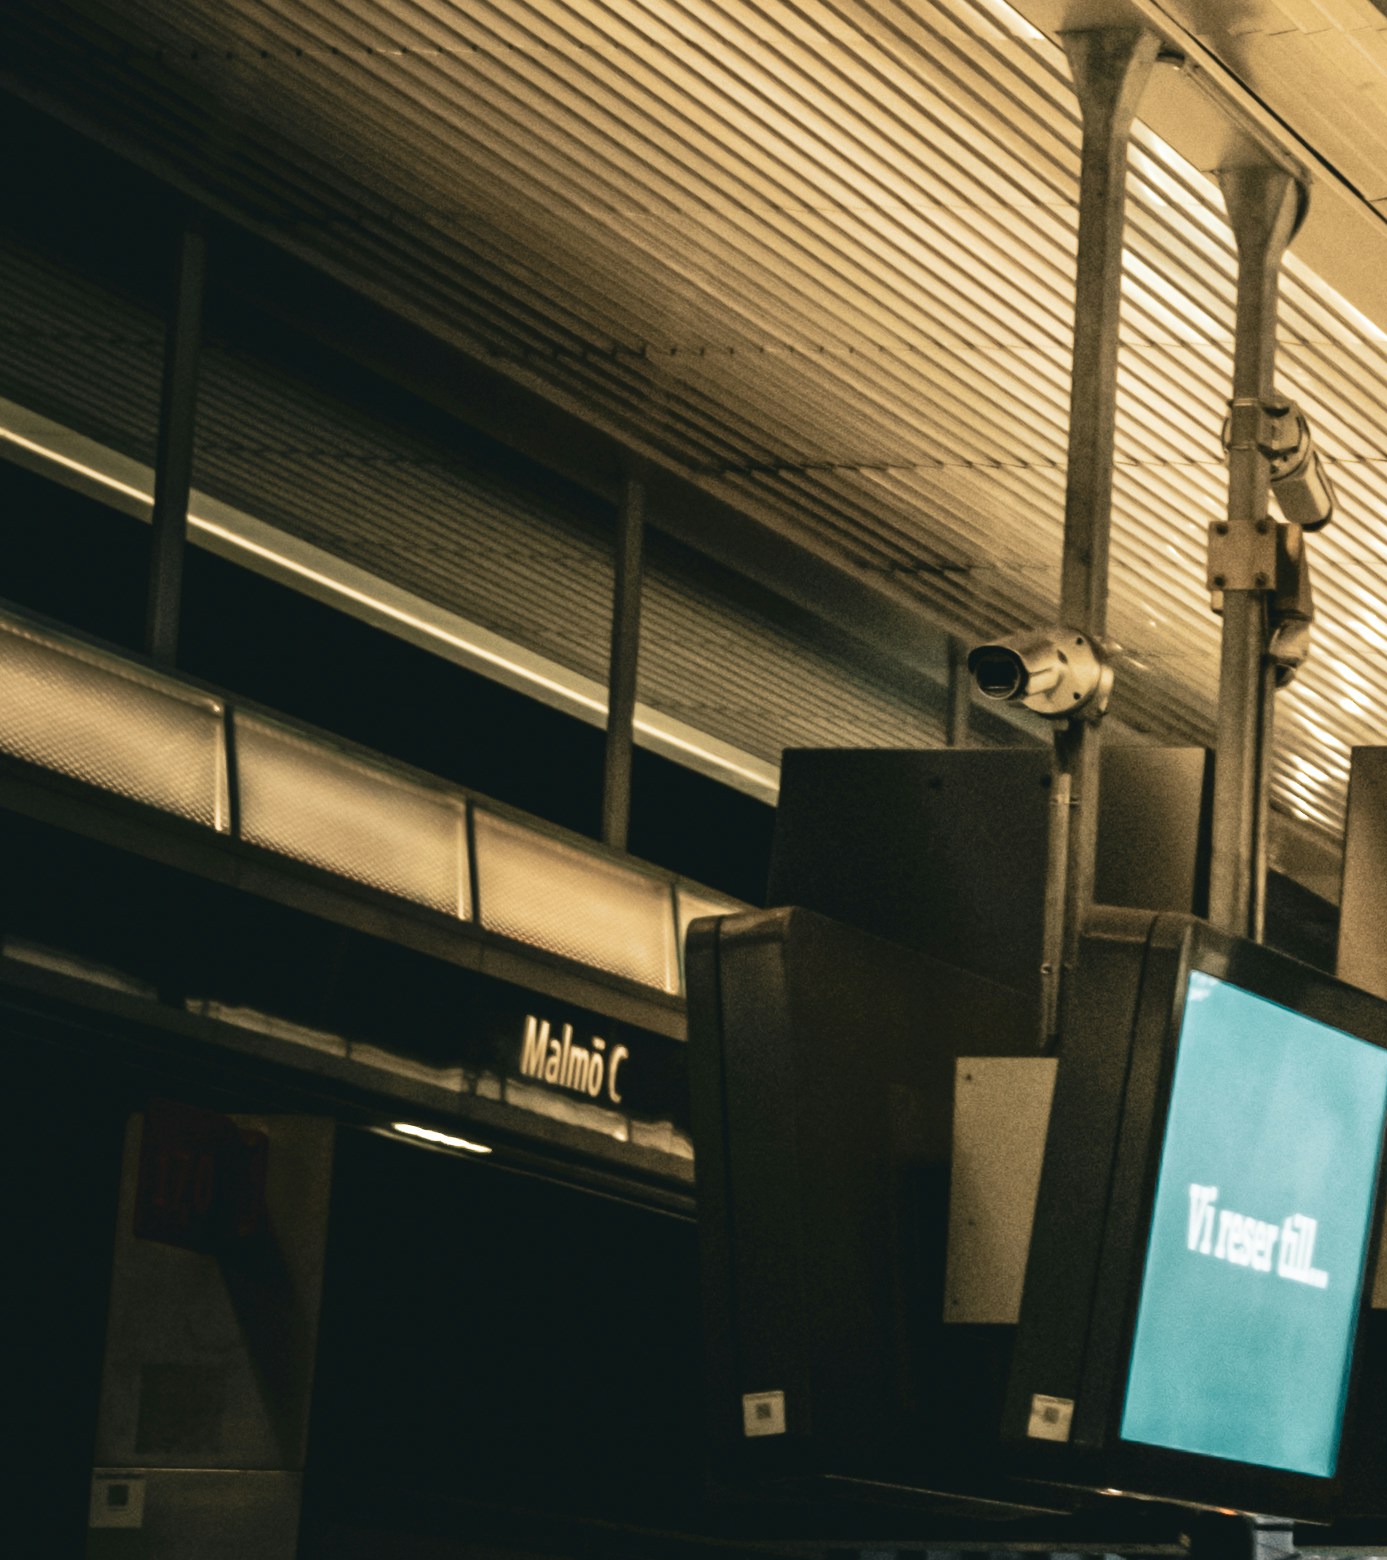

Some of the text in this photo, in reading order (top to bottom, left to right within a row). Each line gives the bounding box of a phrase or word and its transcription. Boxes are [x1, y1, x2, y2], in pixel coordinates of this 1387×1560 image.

[519, 1014, 629, 1103] Malmö C
[1187, 1182, 1219, 1255] Vi
[1214, 1209, 1280, 1273] reser
